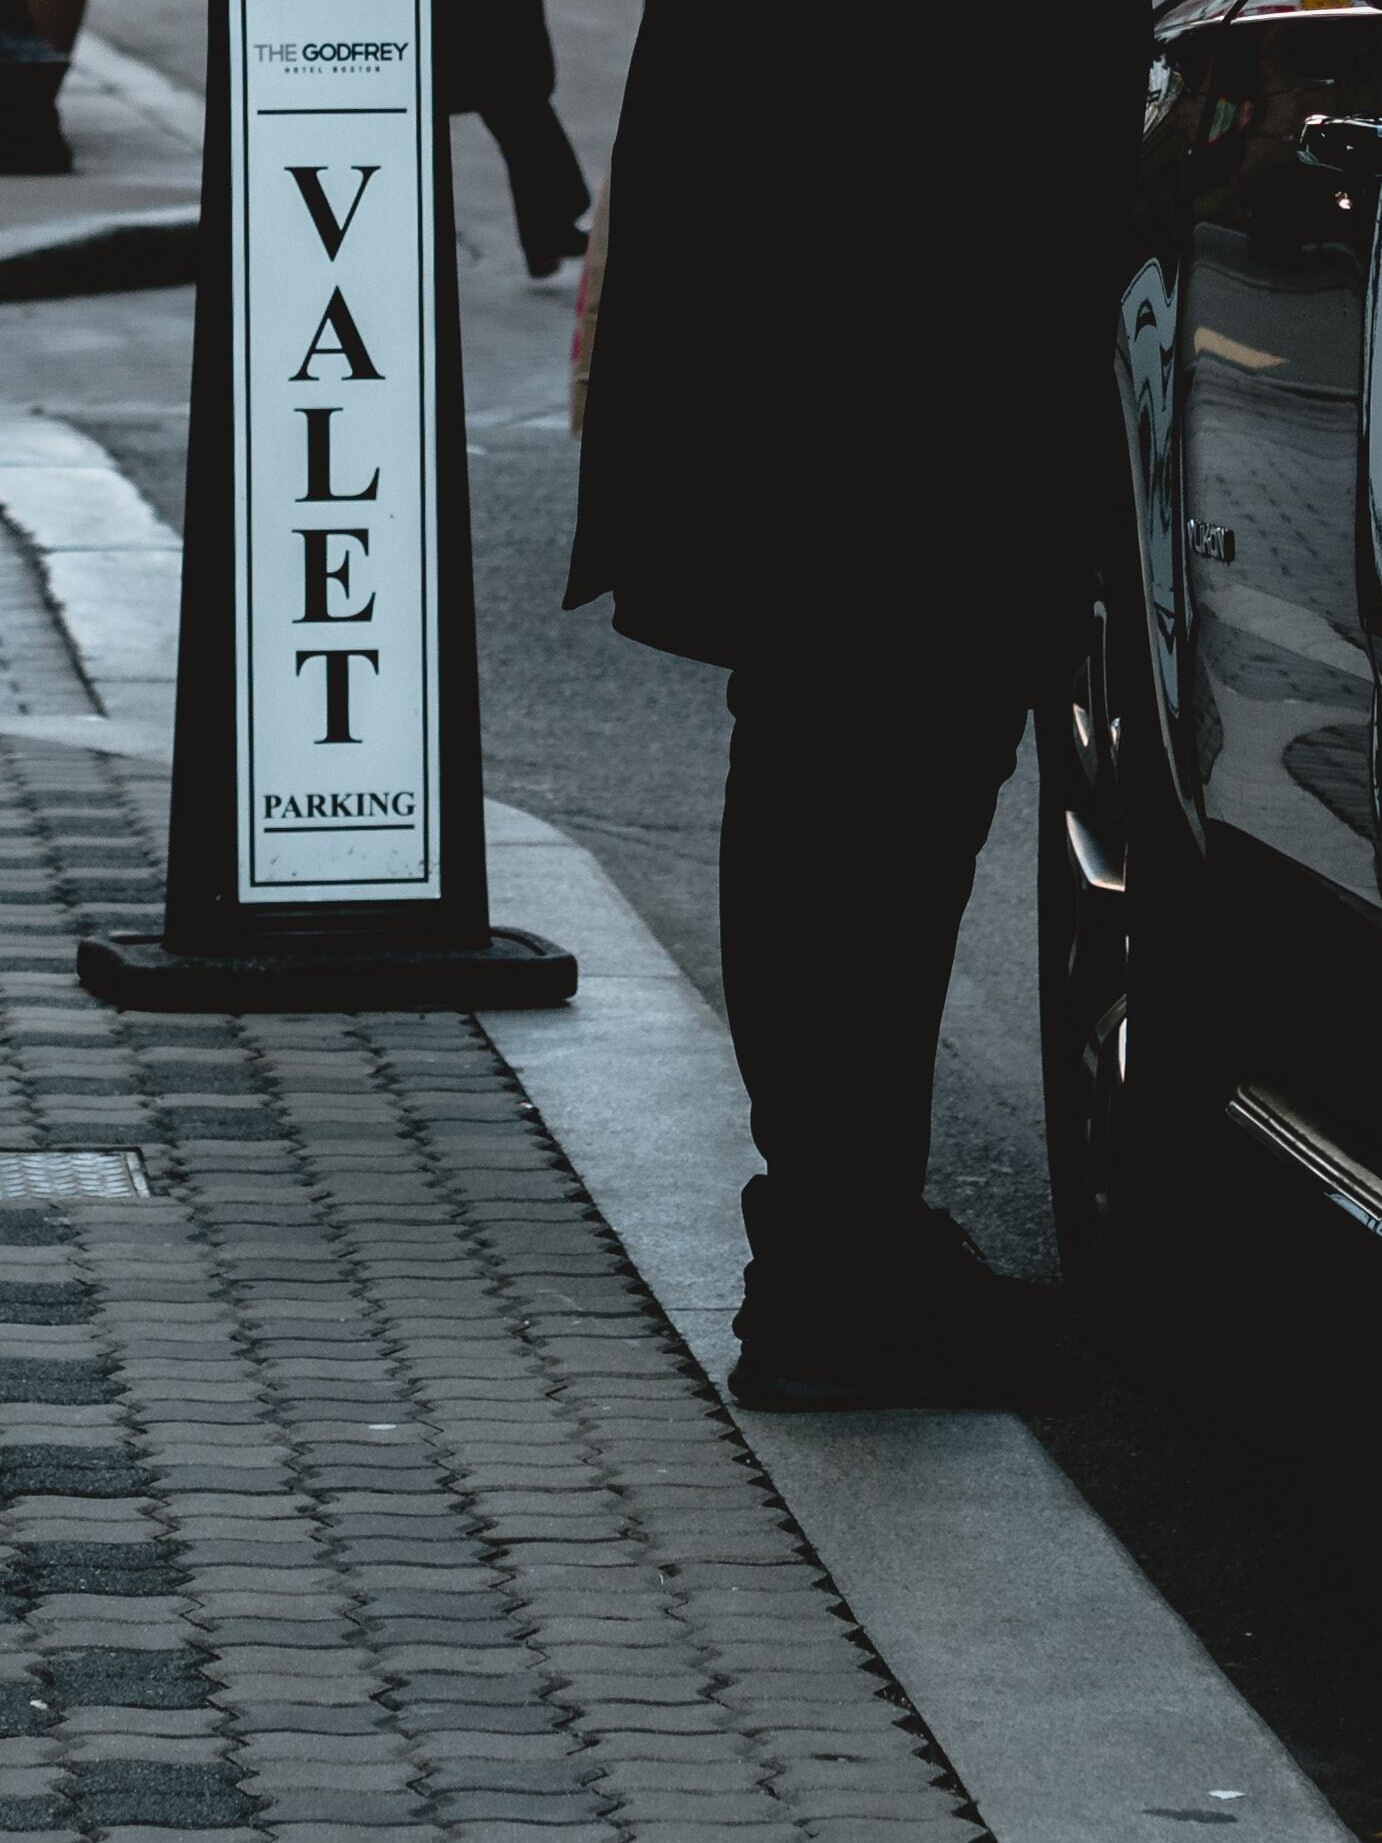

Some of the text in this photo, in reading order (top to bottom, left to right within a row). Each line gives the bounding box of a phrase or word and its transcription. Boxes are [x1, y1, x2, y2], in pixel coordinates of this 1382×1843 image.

[254, 43, 408, 62] THE GODFREY
[284, 164, 386, 745] VALET
[263, 791, 416, 820] PARKING
